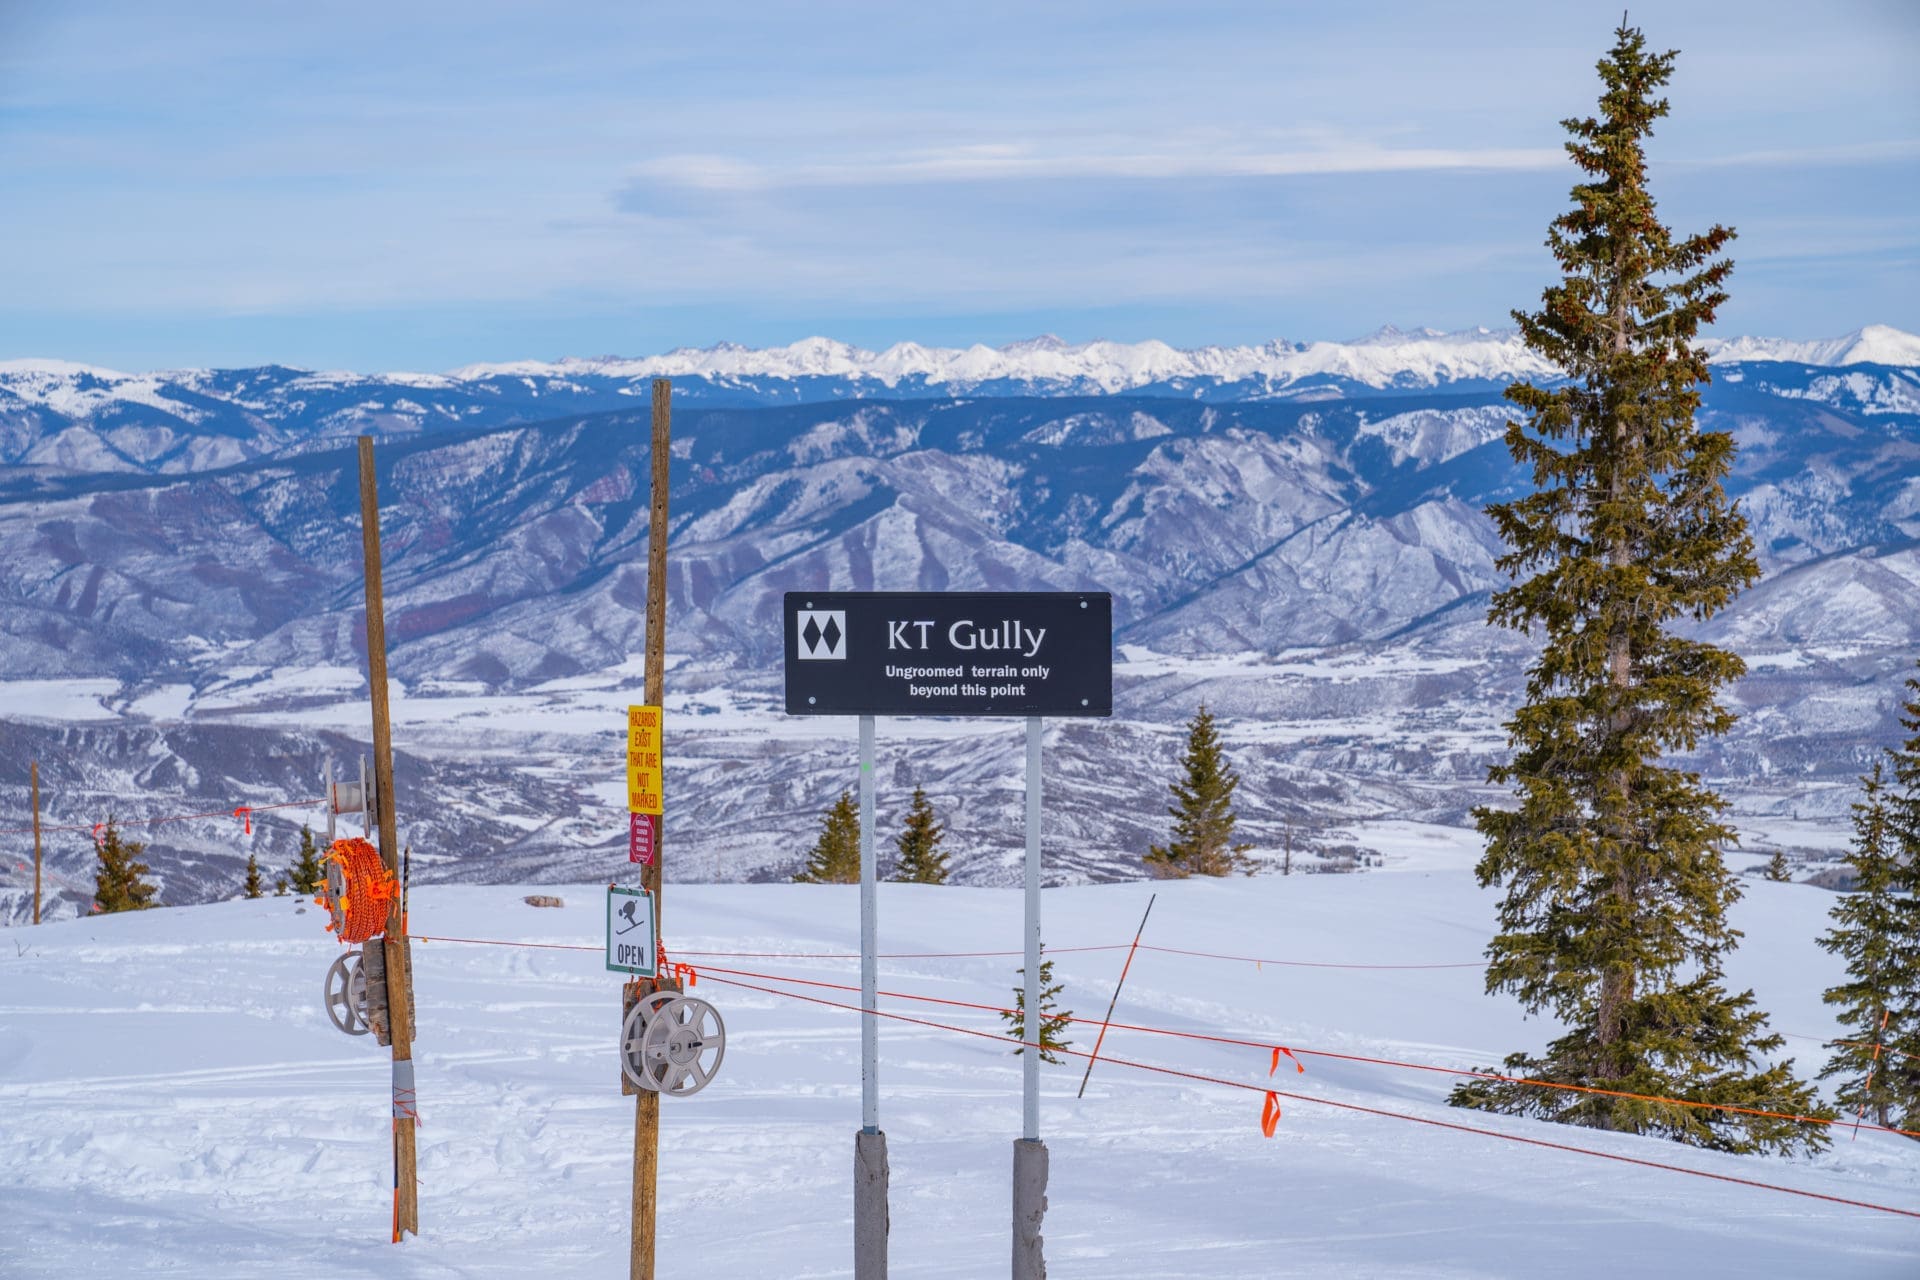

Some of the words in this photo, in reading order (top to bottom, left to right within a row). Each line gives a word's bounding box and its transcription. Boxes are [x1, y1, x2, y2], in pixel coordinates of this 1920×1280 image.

[887, 620, 936, 650] KT
[948, 620, 1047, 657] Gully
[885, 665, 964, 679] Ungroomed
[971, 665, 1018, 678] terrain
[1021, 665, 1050, 680] only
[909, 684, 958, 698] beyond
[960, 684, 987, 696] this
[990, 684, 1026, 698] point
[630, 711, 657, 728] HAZARDS
[635, 731, 651, 747] EXIST
[629, 751, 644, 768] THAT
[645, 752, 657, 769] ARE
[637, 772, 650, 788] NOT
[631, 791, 658, 809] MARKED
[618, 944, 644, 966] OPEN
